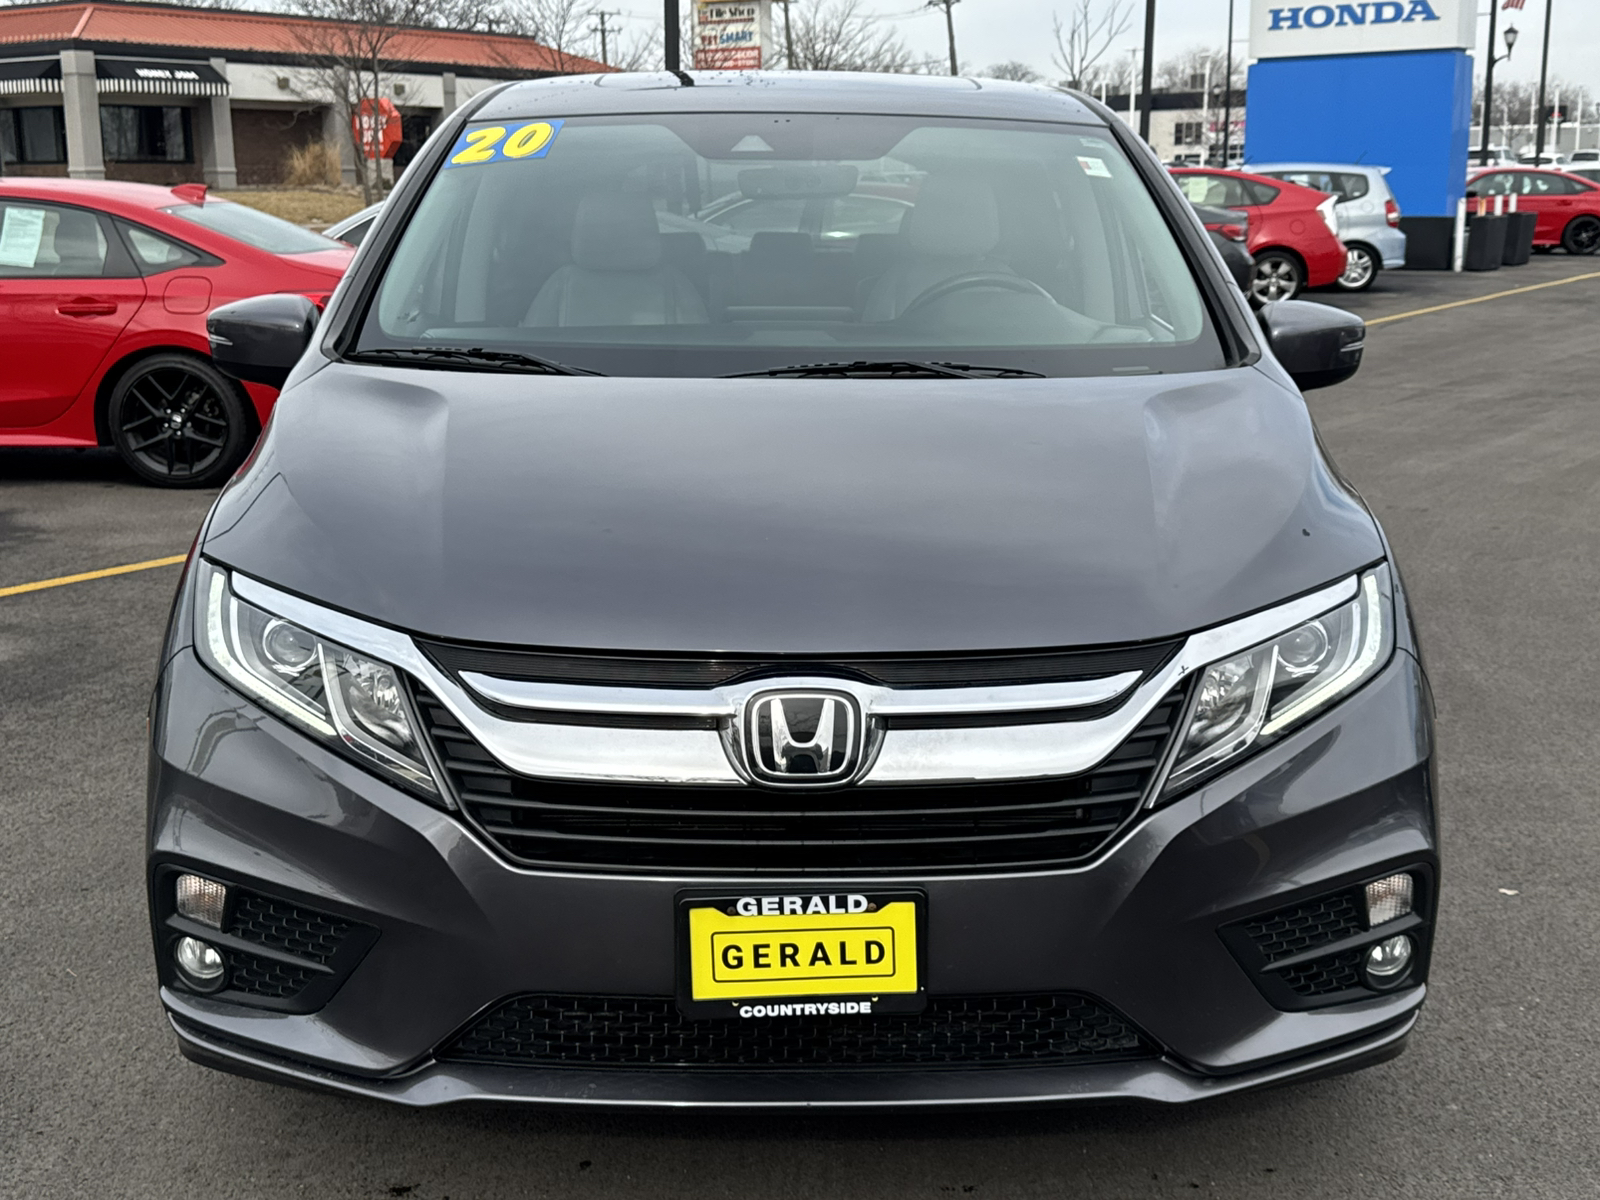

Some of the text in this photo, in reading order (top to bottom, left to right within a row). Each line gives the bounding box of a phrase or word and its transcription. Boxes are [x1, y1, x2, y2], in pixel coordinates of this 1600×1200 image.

[1268, 0, 1440, 31] HONDA
[451, 122, 554, 164] 20
[736, 894, 868, 916] GERALD
[721, 940, 886, 970] GERALD
[739, 1002, 872, 1018] COUNTRYSIDE
